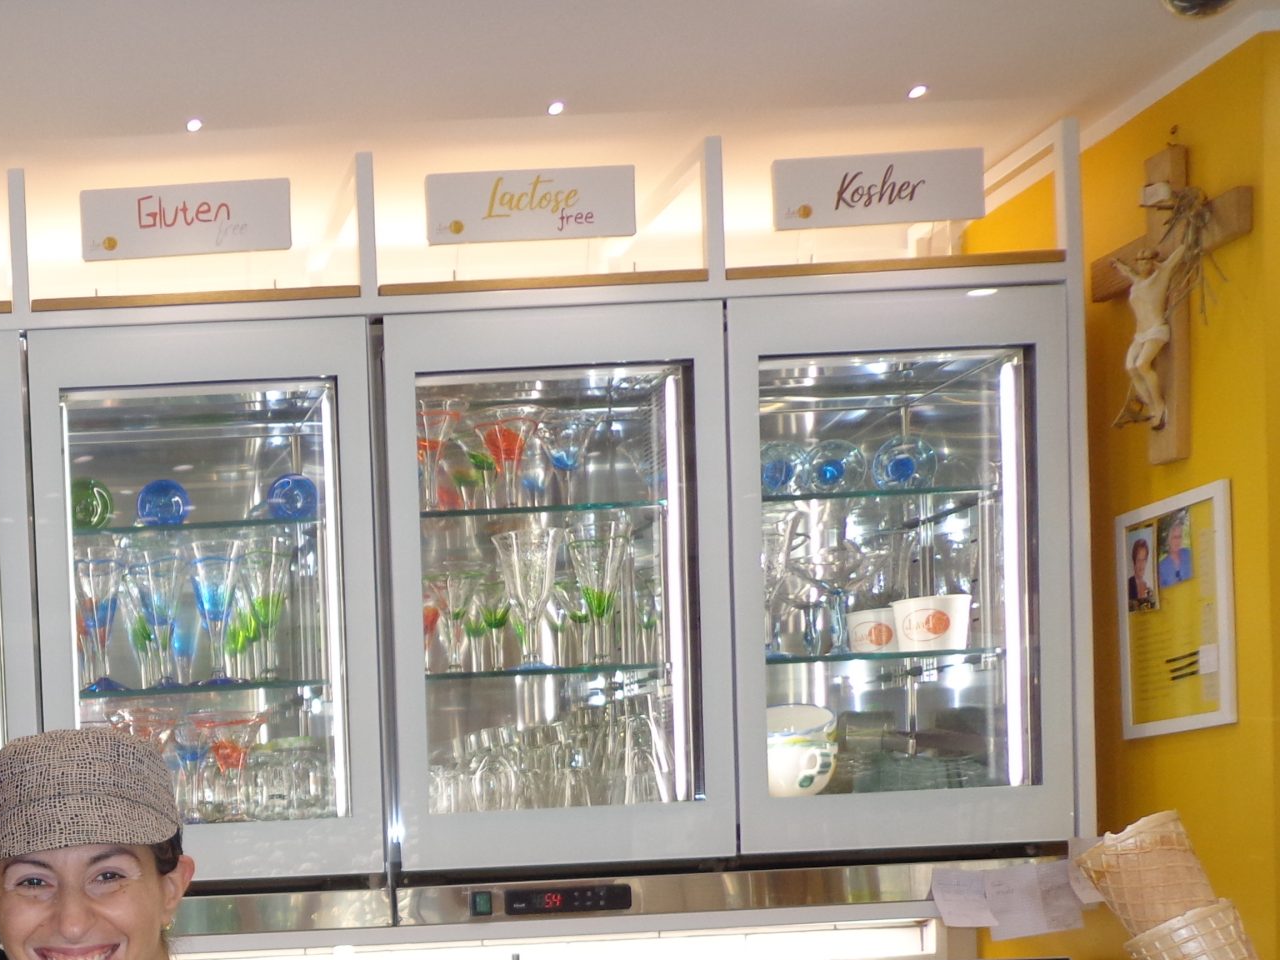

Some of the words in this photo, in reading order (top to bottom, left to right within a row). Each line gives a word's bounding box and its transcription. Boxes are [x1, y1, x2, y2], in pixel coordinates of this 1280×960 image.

[481, 173, 580, 220] Lactose
[834, 163, 926, 211] Kosher
[137, 195, 231, 230] Gluten
[557, 207, 595, 231] free
